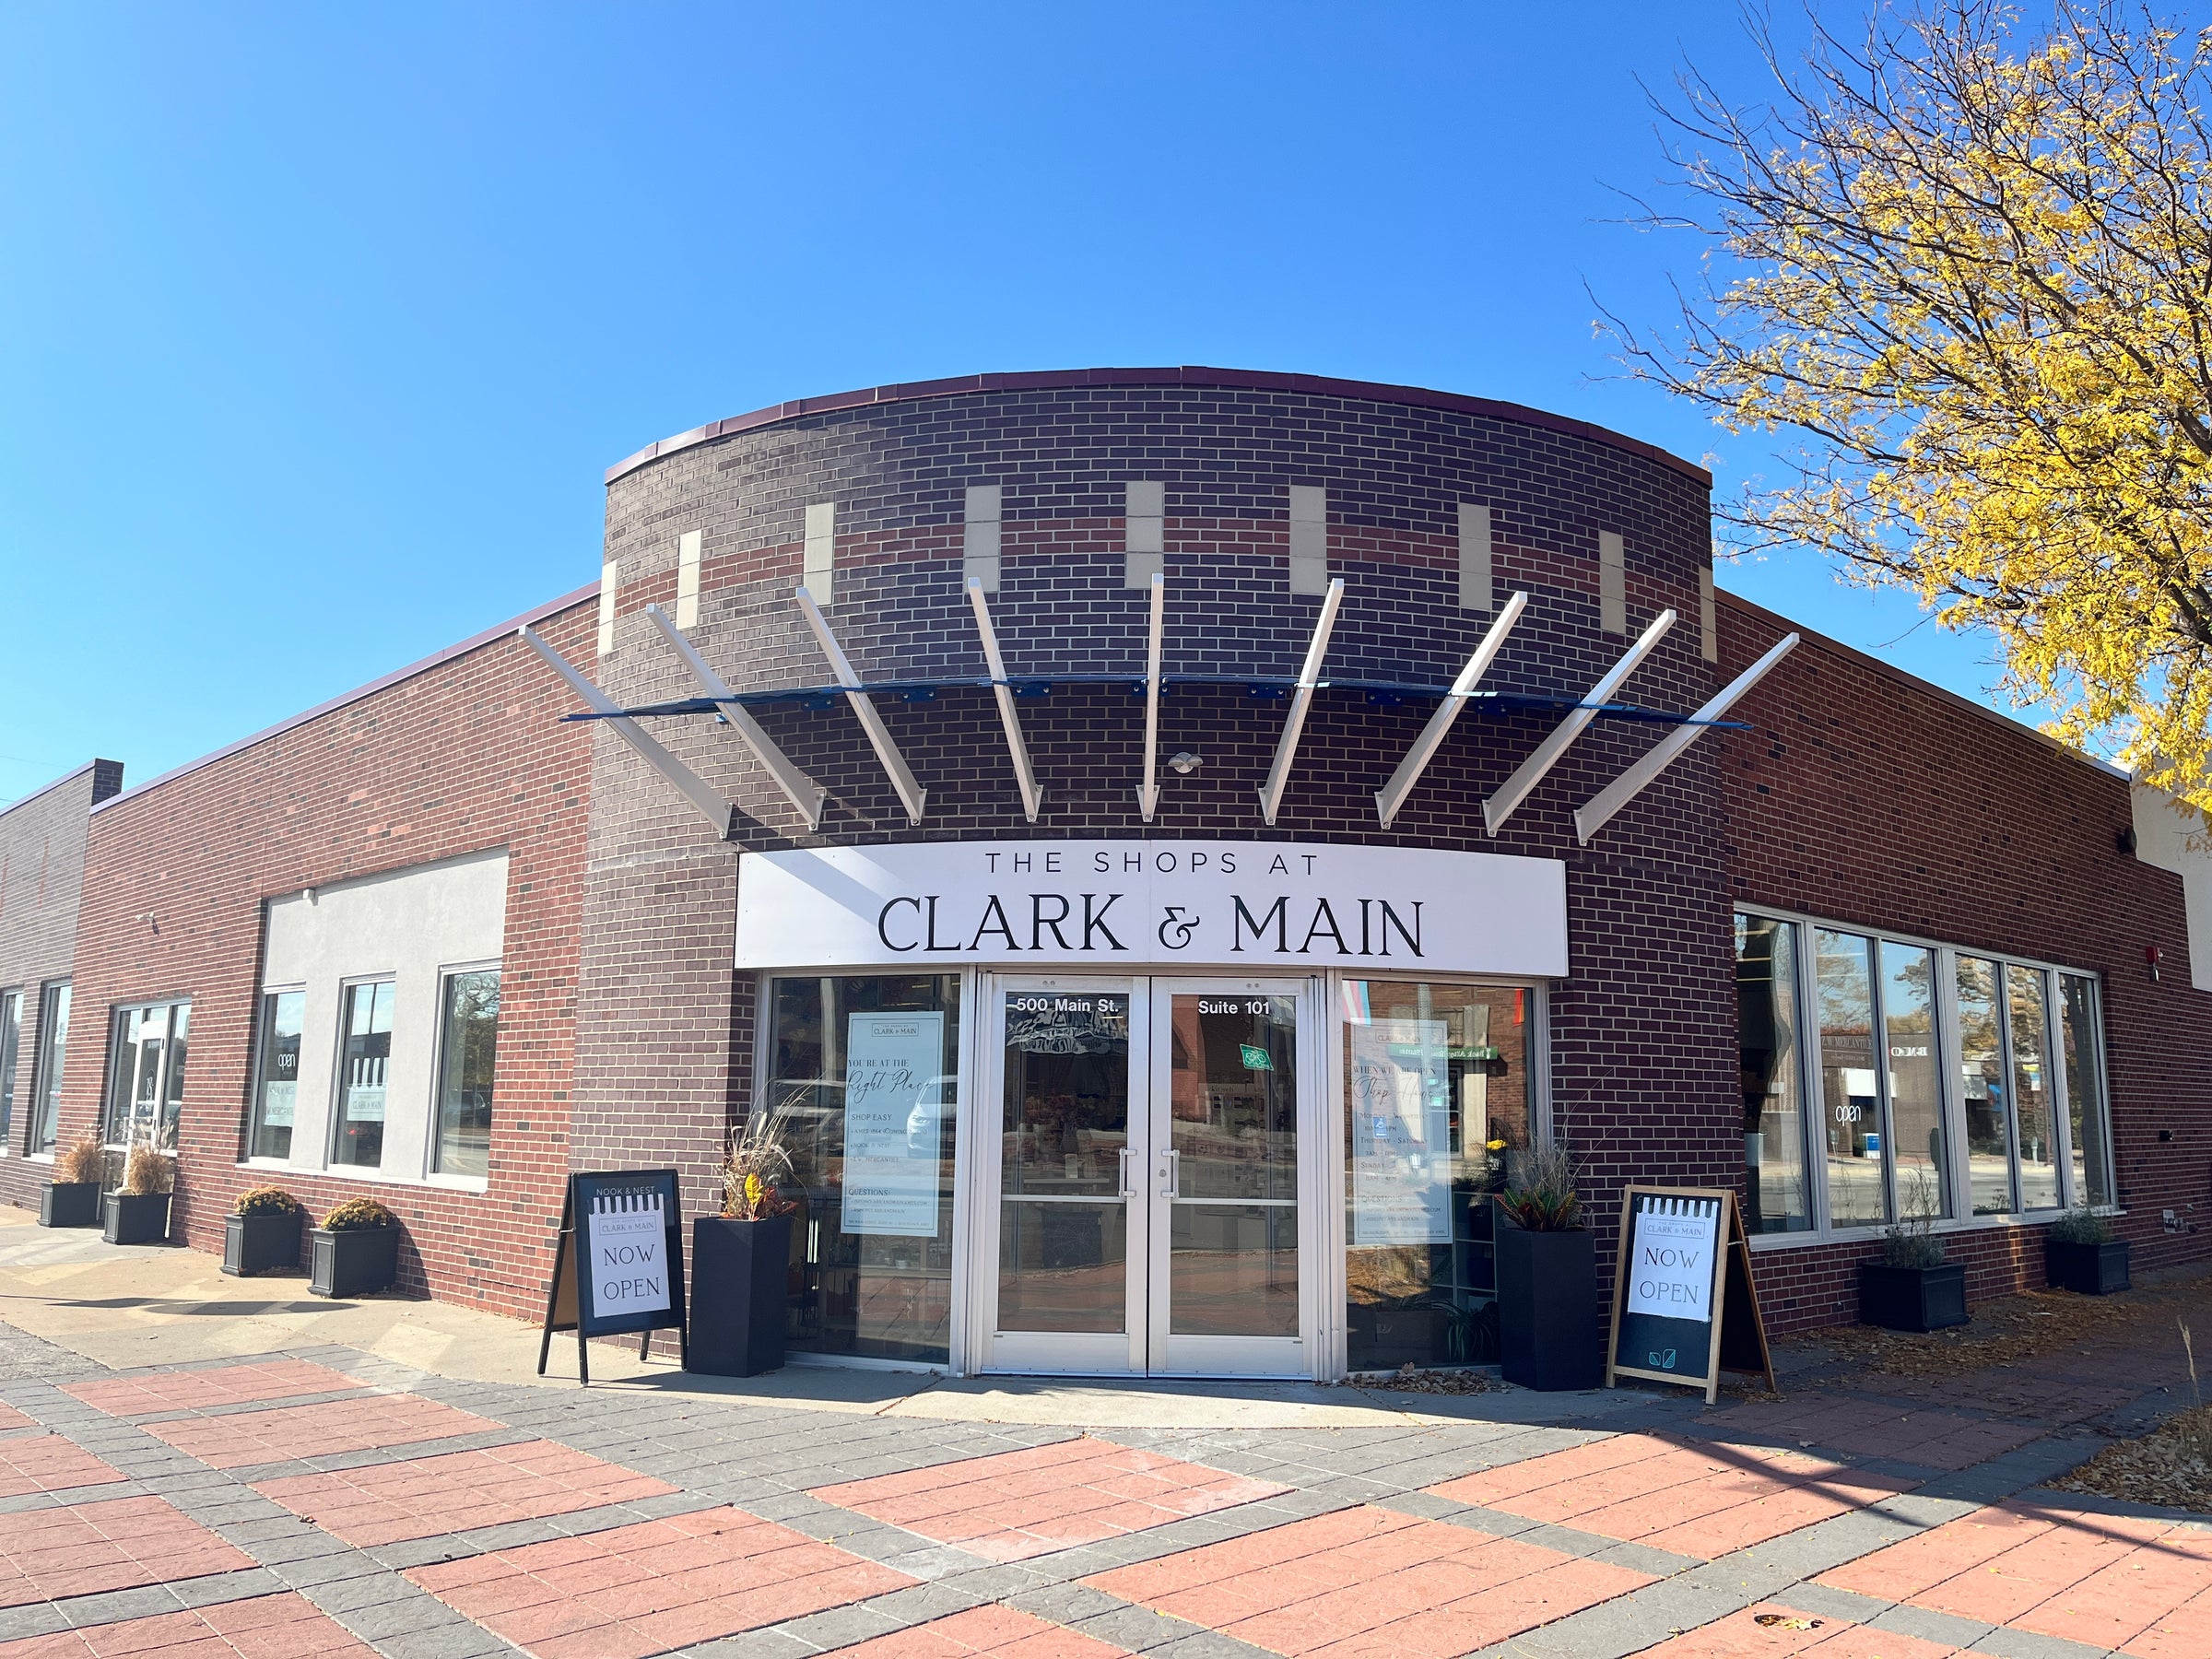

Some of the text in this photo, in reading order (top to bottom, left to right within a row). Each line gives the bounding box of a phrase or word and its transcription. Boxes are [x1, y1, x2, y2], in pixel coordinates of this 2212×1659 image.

[985, 852, 1317, 876] THE SHOPS AT
[877, 893, 1425, 958] CLARK & MAIN
[1017, 998, 1119, 1013] 500 Main St.
[1198, 1000, 1269, 1015] Suite 101
[278, 1053, 296, 1070] open
[847, 1069, 887, 1104] Right
[1835, 1105, 1862, 1127] open
[596, 1185, 655, 1196] NOOK & NEST
[602, 1223, 627, 1232] CLARK
[634, 1222, 654, 1230] MAIN
[1647, 1225, 1673, 1234] CLARK
[1681, 1227, 1702, 1236] MAIN
[604, 1243, 655, 1266] NOW
[1644, 1246, 1700, 1269] NOW
[604, 1277, 660, 1300] OPEN
[1640, 1280, 1700, 1305] OPEN
